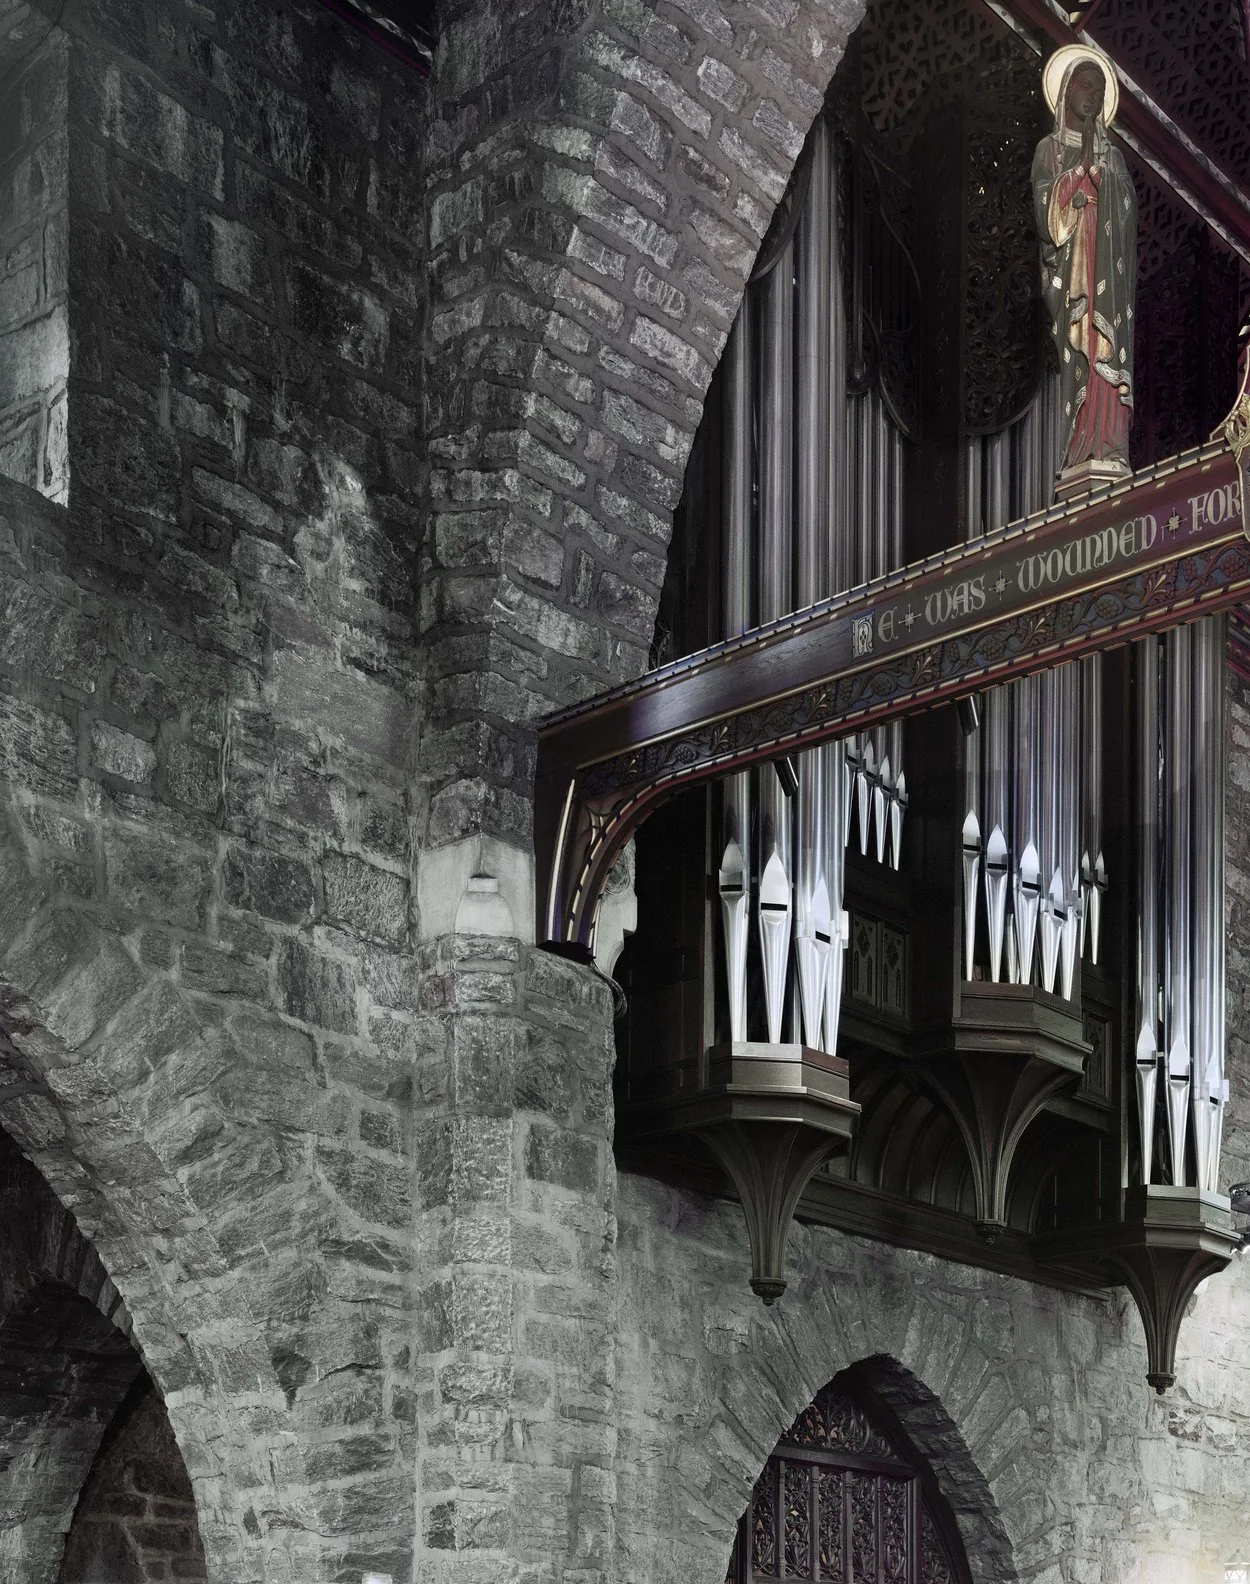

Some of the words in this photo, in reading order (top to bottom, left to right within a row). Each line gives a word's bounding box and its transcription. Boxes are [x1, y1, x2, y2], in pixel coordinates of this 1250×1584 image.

[925, 574, 989, 626] WAS
[1016, 513, 1159, 593] WOUNDED
[1188, 480, 1242, 534] FOR
